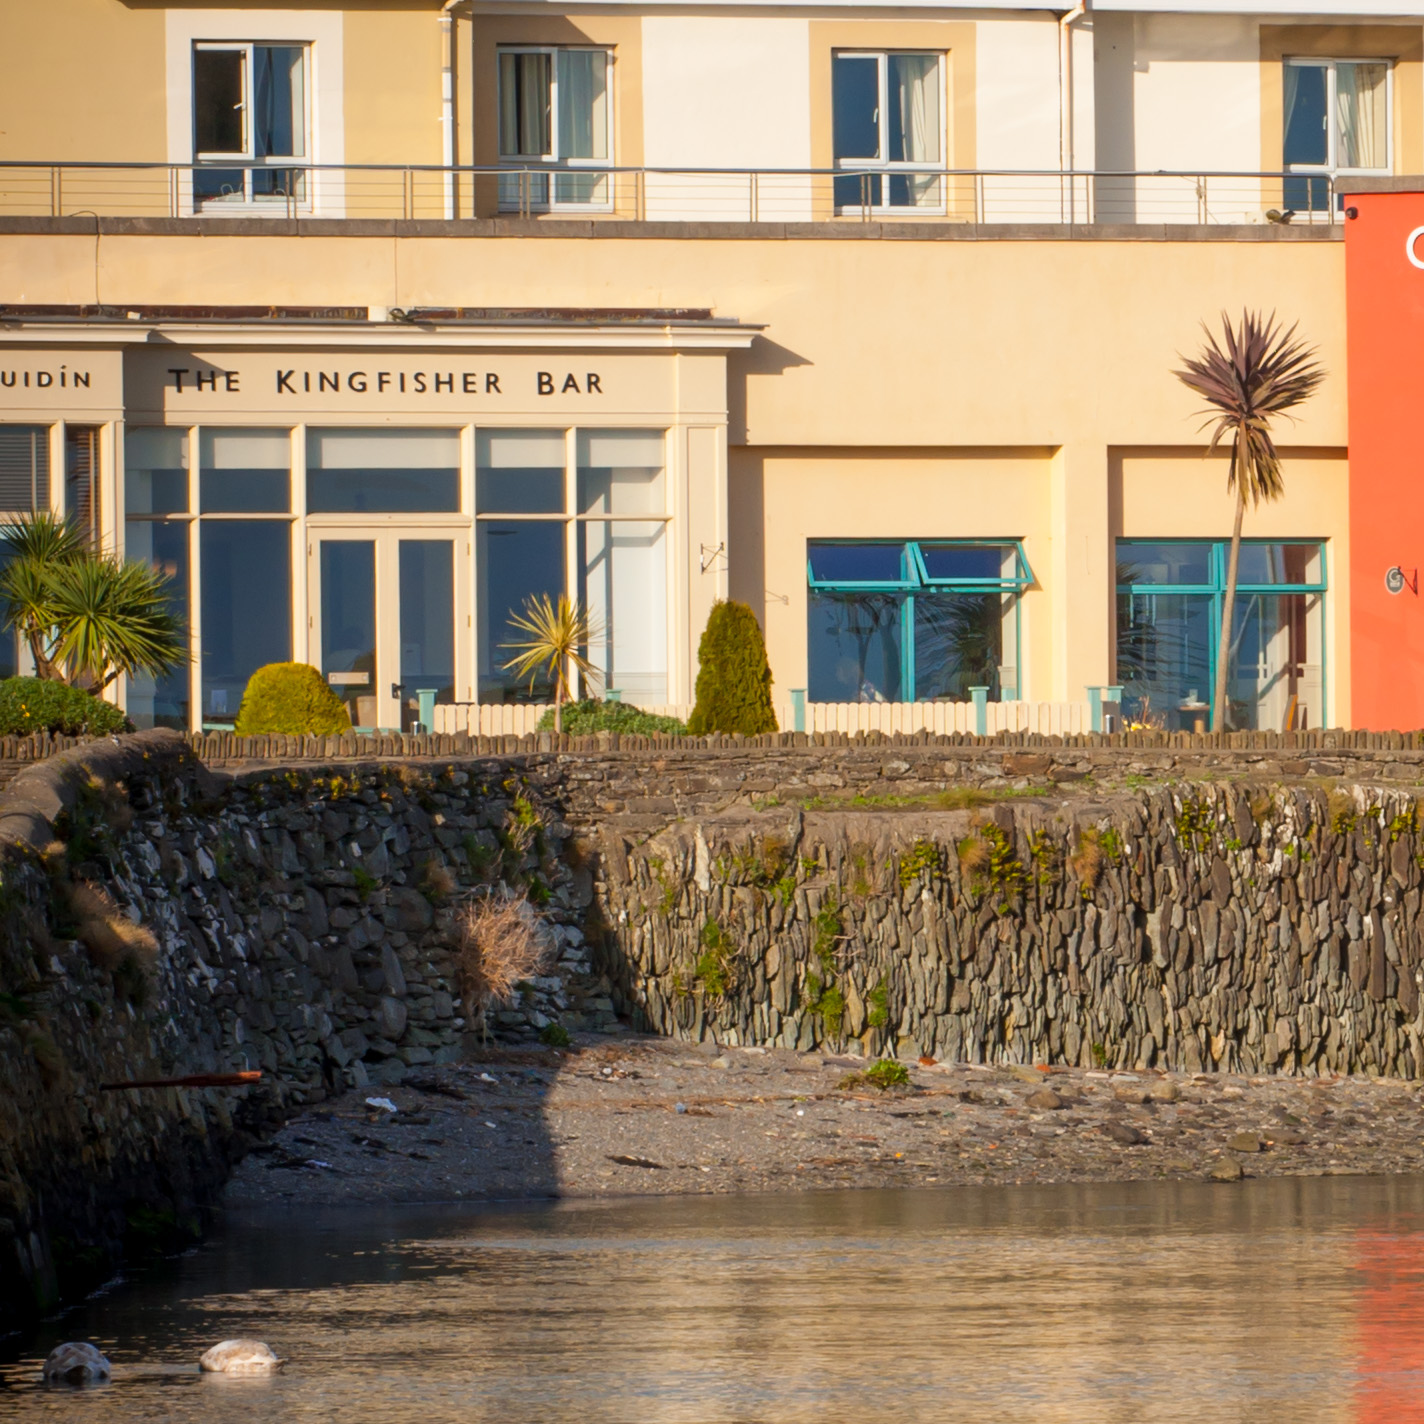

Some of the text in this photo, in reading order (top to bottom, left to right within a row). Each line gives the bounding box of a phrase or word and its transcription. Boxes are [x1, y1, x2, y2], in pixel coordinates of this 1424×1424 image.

[167, 368, 604, 396] THE KINGFISHER BAR
